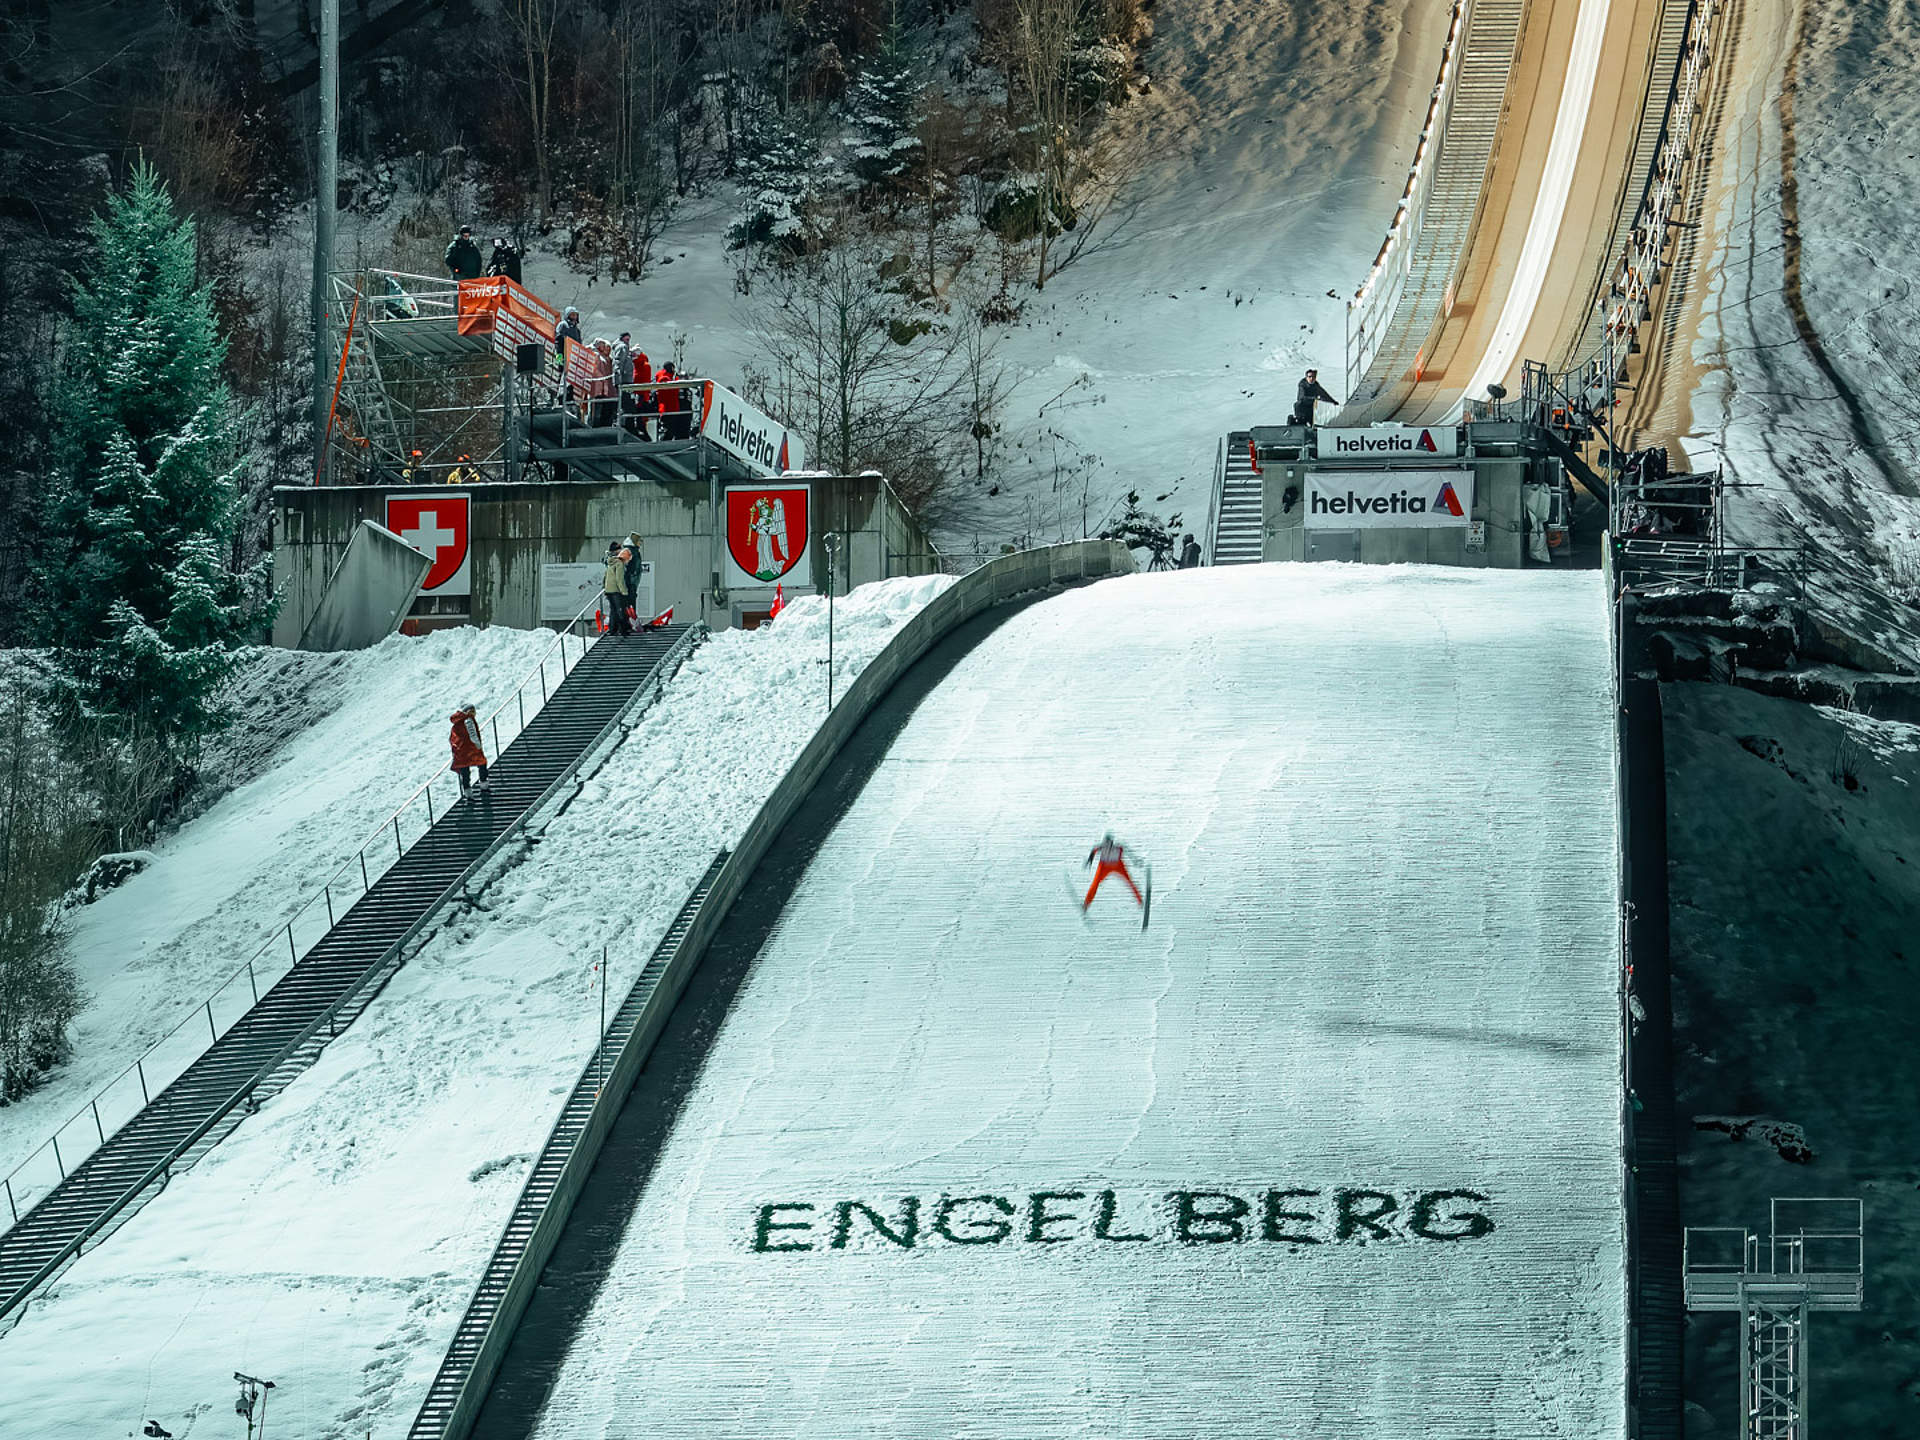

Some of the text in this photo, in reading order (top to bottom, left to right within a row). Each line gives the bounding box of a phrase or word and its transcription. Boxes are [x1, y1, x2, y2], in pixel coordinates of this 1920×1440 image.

[719, 402, 775, 468] helvetia
[1337, 435, 1412, 452] helvetia
[1311, 490, 1426, 514] helvetia
[753, 1187, 1496, 1253] ENGELBERG
